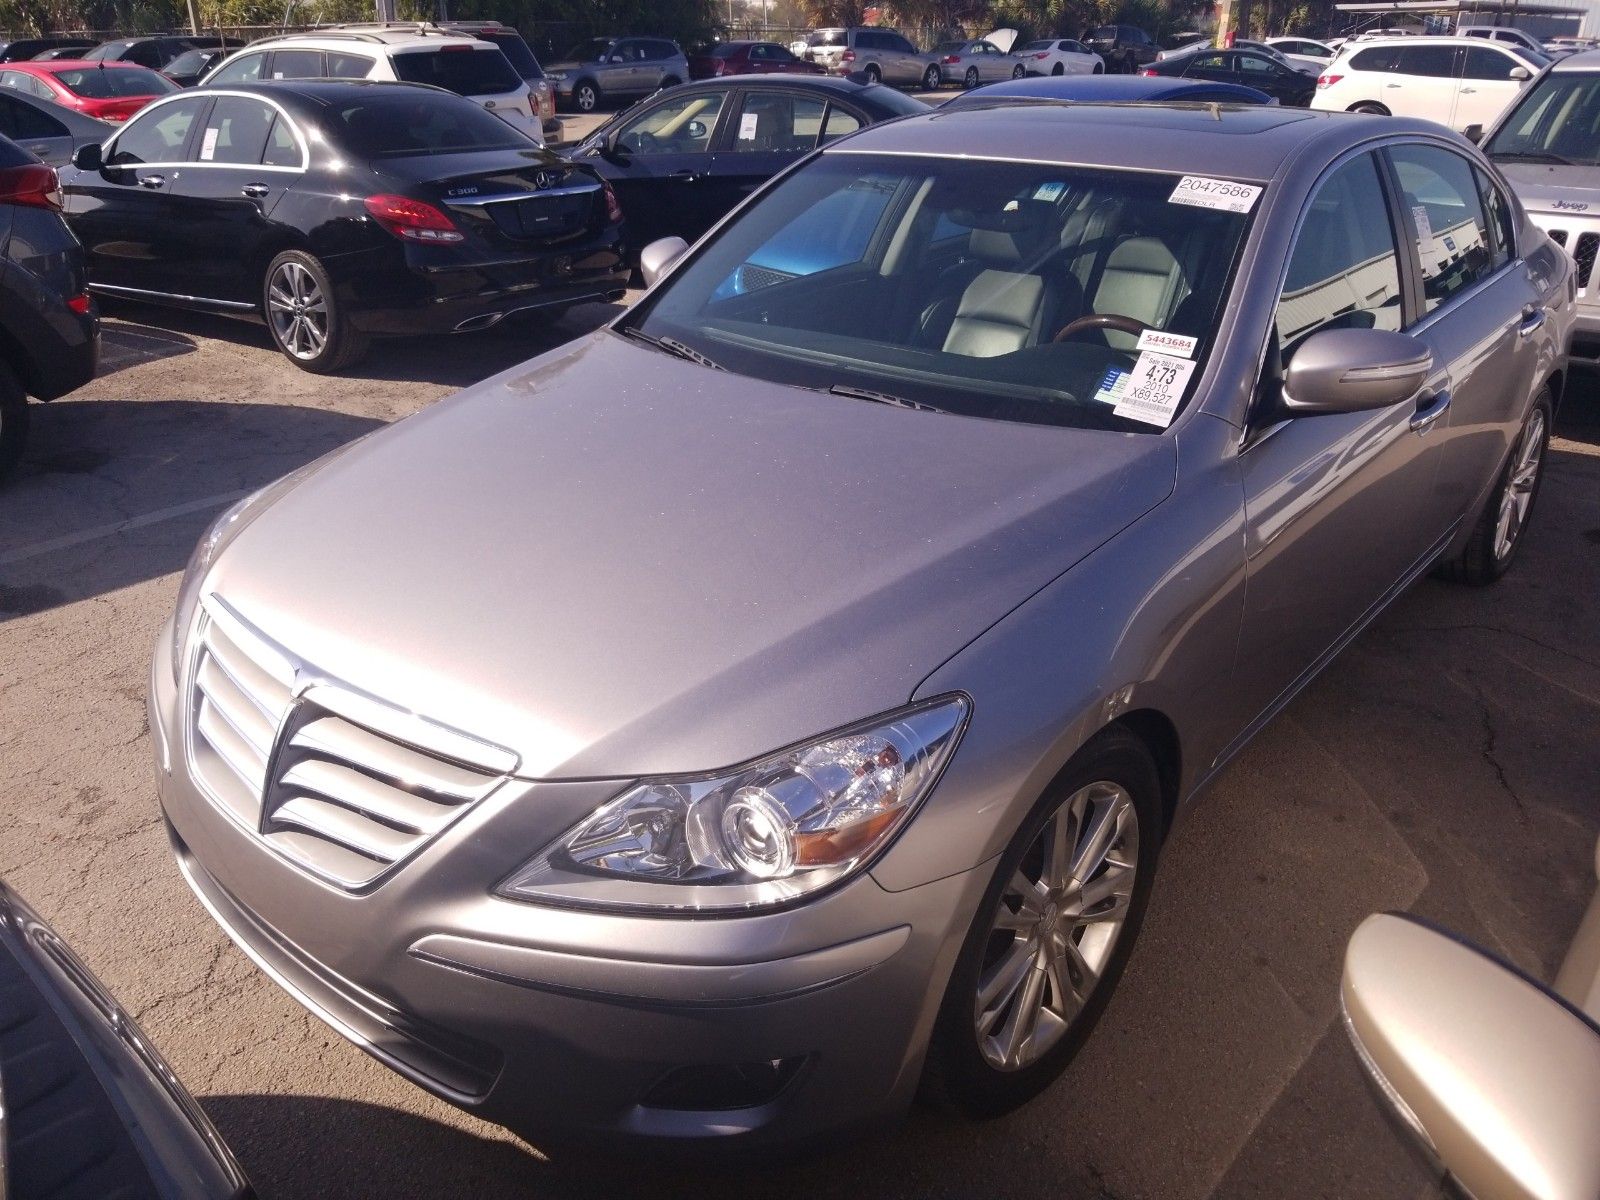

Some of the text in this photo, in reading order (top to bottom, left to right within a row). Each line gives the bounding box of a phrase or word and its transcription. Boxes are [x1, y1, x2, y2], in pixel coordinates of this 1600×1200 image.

[1180, 179, 1252, 198] 2047586
[1552, 200, 1589, 211] Jeep
[1146, 334, 1192, 348] 5443684
[1146, 365, 1177, 385] 4:73
[1143, 380, 1169, 393] 2010
[1130, 387, 1173, 405] X89,527
